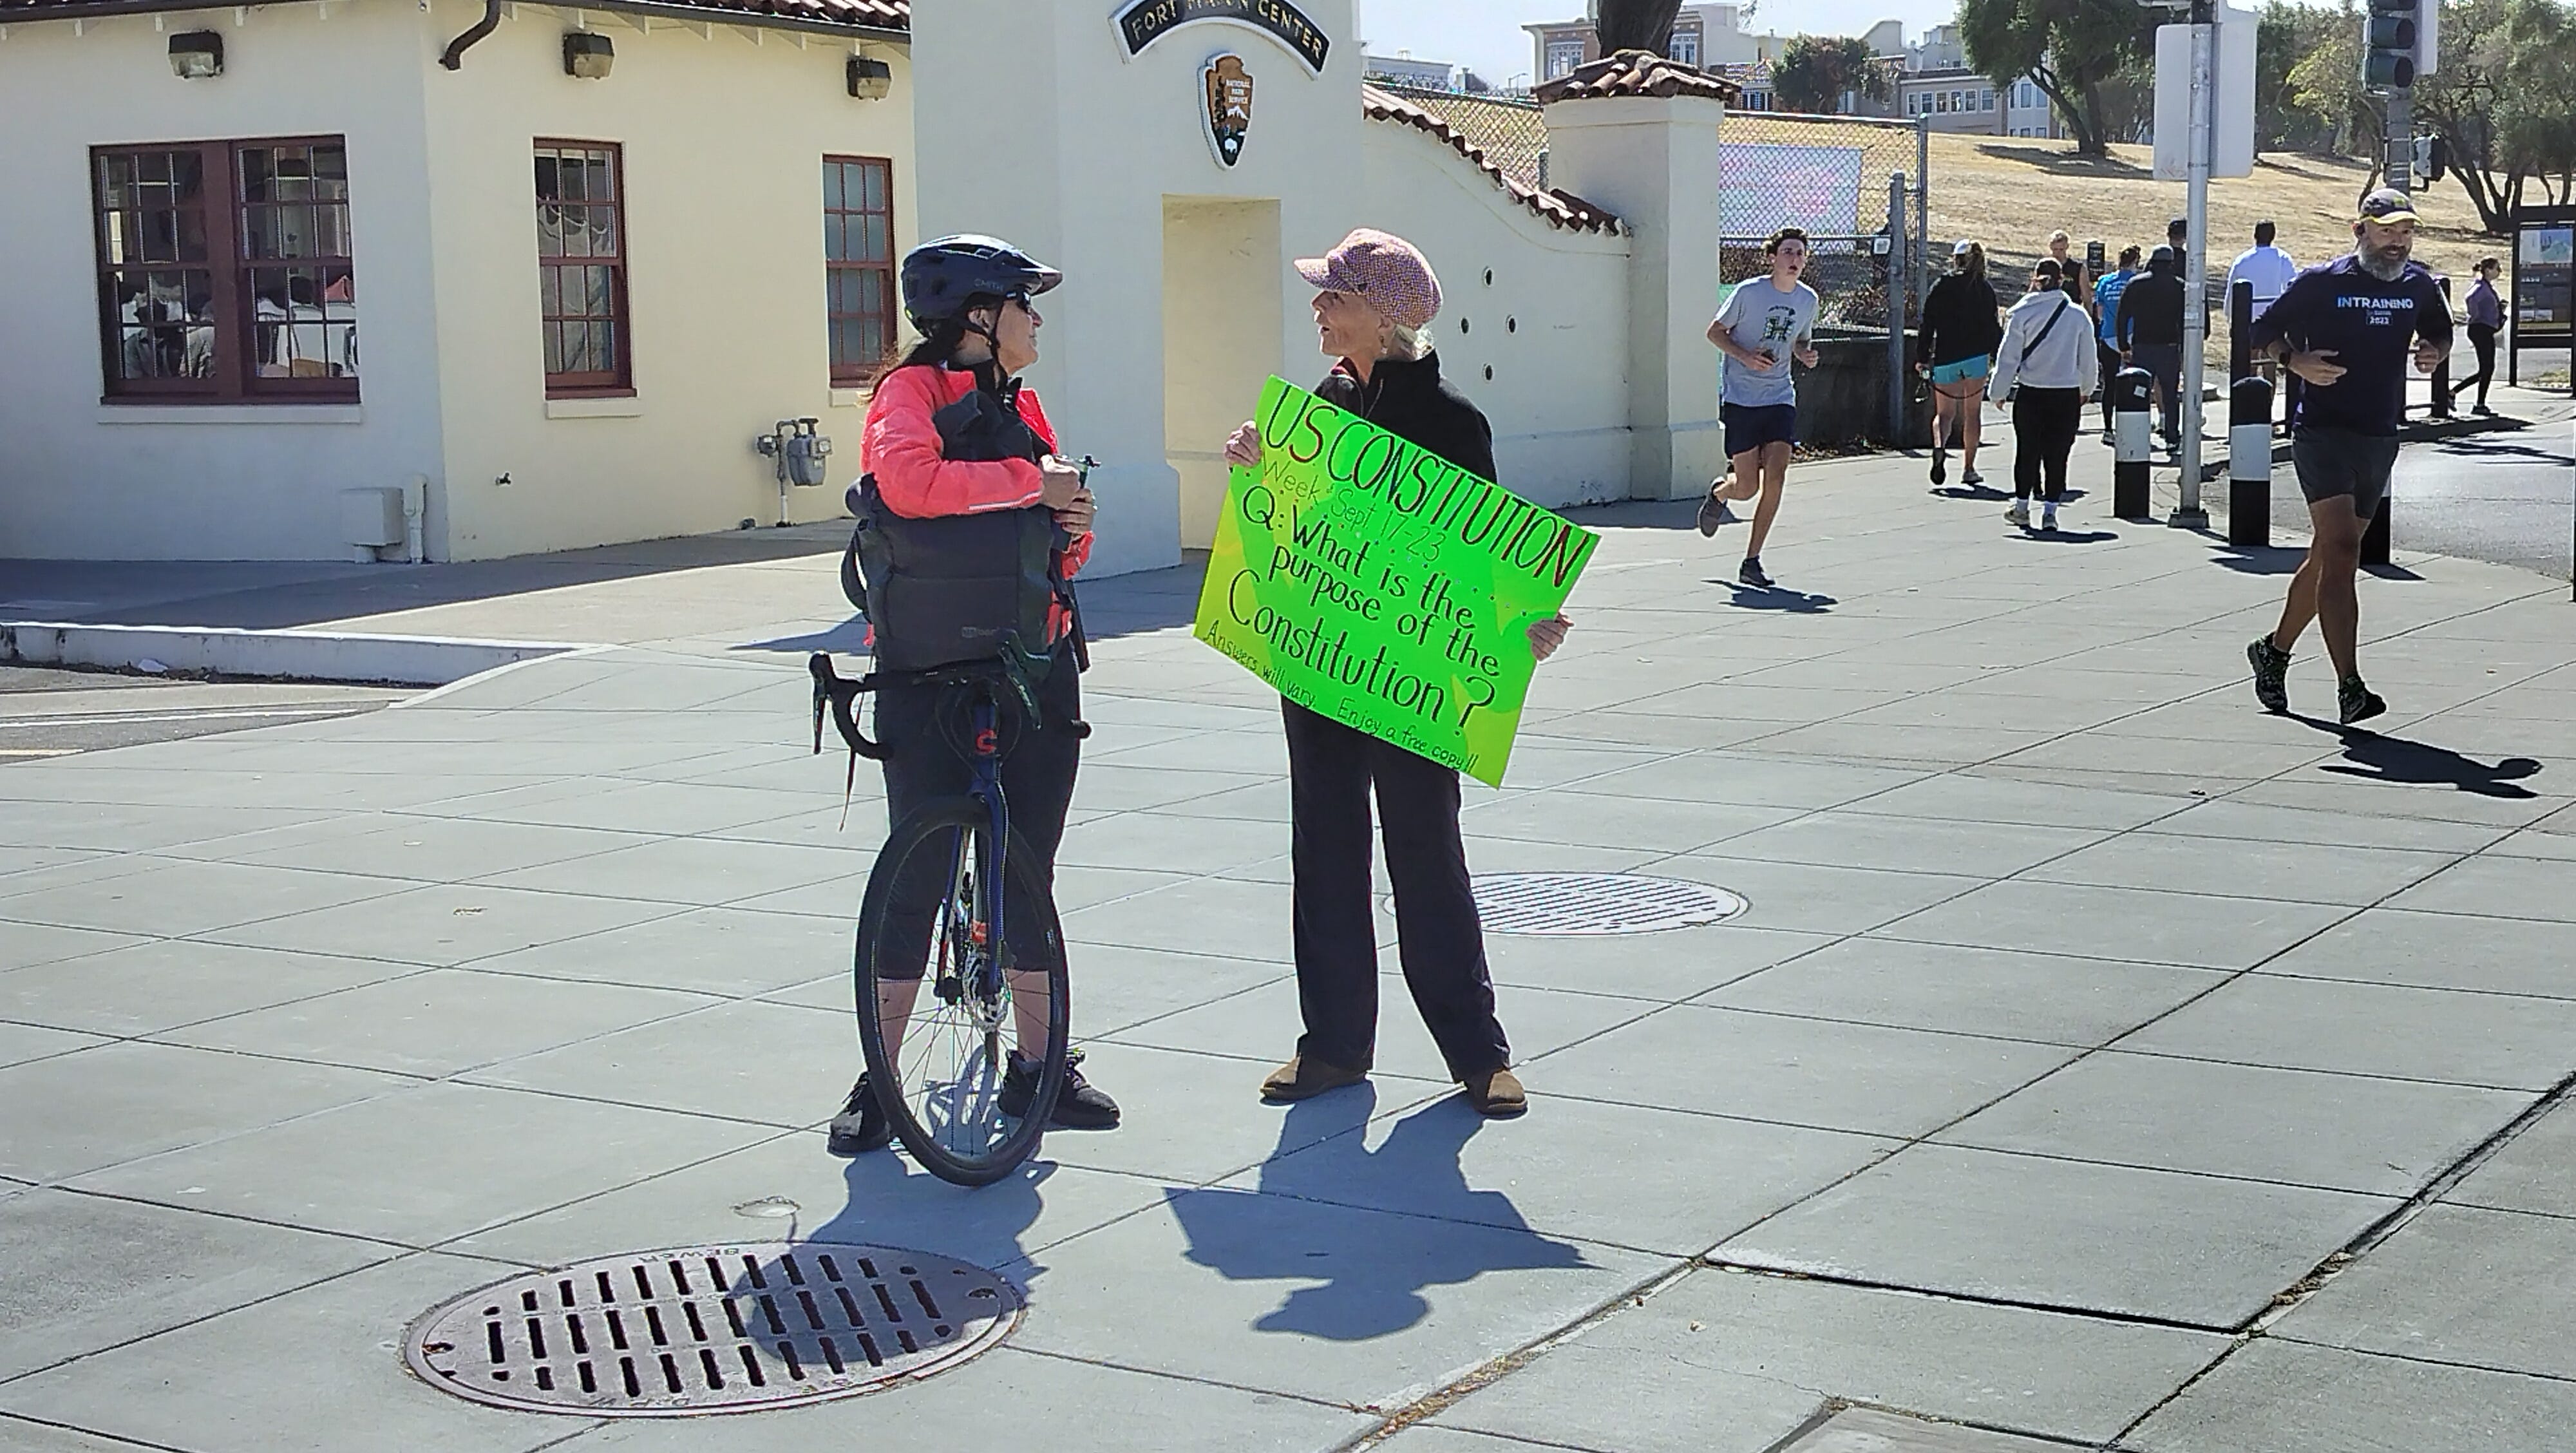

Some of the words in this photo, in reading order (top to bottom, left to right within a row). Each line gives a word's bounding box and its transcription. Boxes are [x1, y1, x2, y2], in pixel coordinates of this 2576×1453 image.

[1130, 0, 1177, 41] FORT
[1257, 0, 1323, 59] CENTER
[1243, 486, 1284, 531] Q:
[1293, 504, 1370, 578] What
[1379, 562, 1409, 597] is
[1420, 573, 1475, 629] the
[1264, 450, 1321, 506] Week
[1380, 510, 1447, 562] 17-23
[1327, 420, 1590, 587] CONSTITUTION
[1268, 545, 1381, 621] purpose
[1397, 613, 1440, 645] of
[1445, 627, 1500, 676] the
[1202, 619, 1258, 671] Answers
[1263, 665, 1286, 688] will
[1336, 697, 1381, 735] Enjoy
[1386, 726, 1396, 739] a
[1401, 725, 1427, 752] free
